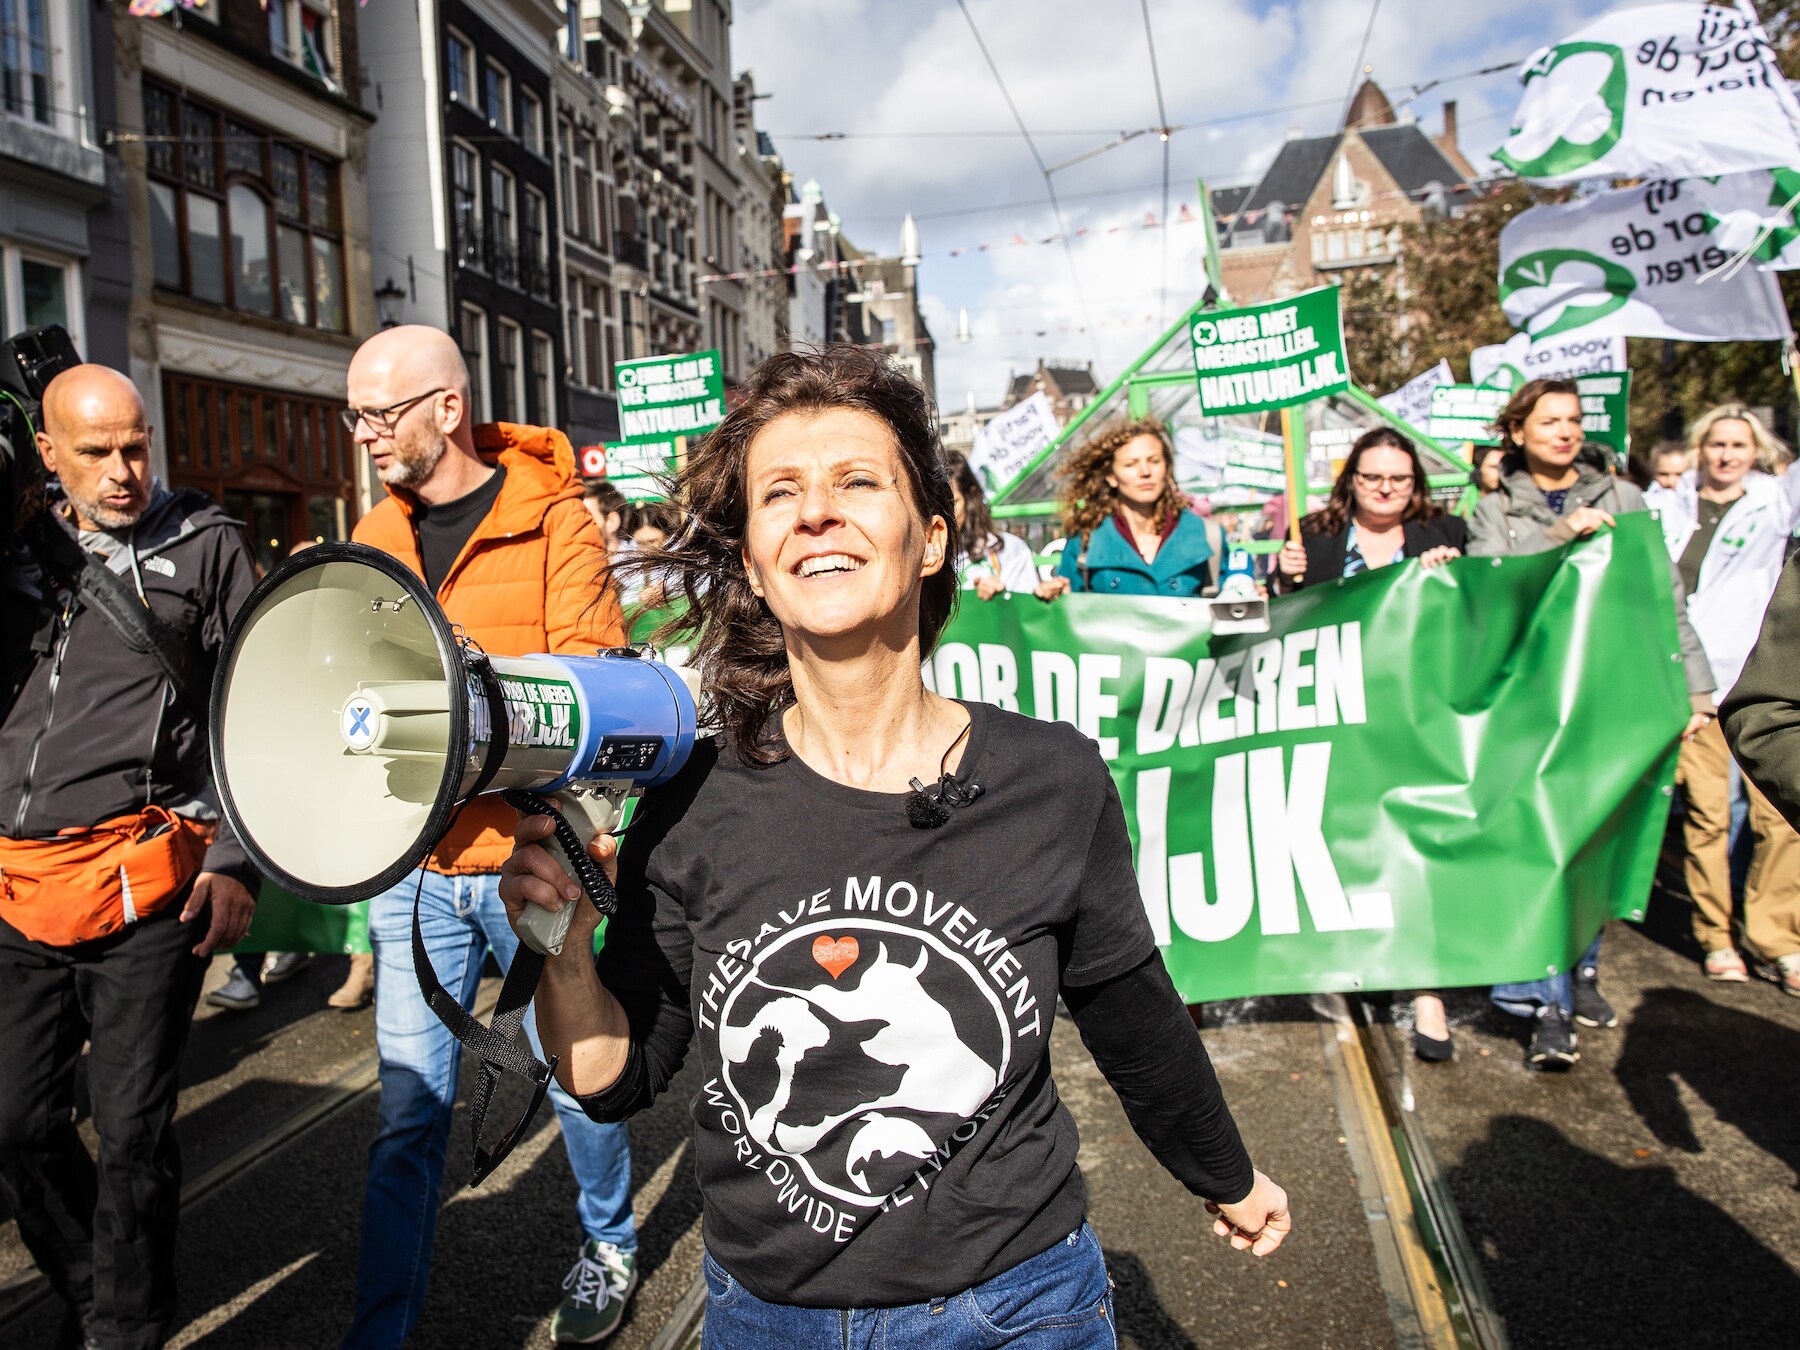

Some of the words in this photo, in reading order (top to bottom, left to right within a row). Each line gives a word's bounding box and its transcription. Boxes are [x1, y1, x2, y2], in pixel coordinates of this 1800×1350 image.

[1216, 315, 1260, 343] WEG
[1259, 306, 1298, 338] MET
[524, 683, 541, 703] DE
[538, 684, 575, 704] DIEREN
[920, 642, 1019, 714] OR
[1031, 650, 1121, 760] DE
[1136, 621, 1366, 755] DIEREN
[1136, 741, 1395, 946] IJK.
[844, 876, 1041, 1037] MOVEMENT
[704, 1078, 857, 1242] WORLDWIDE
